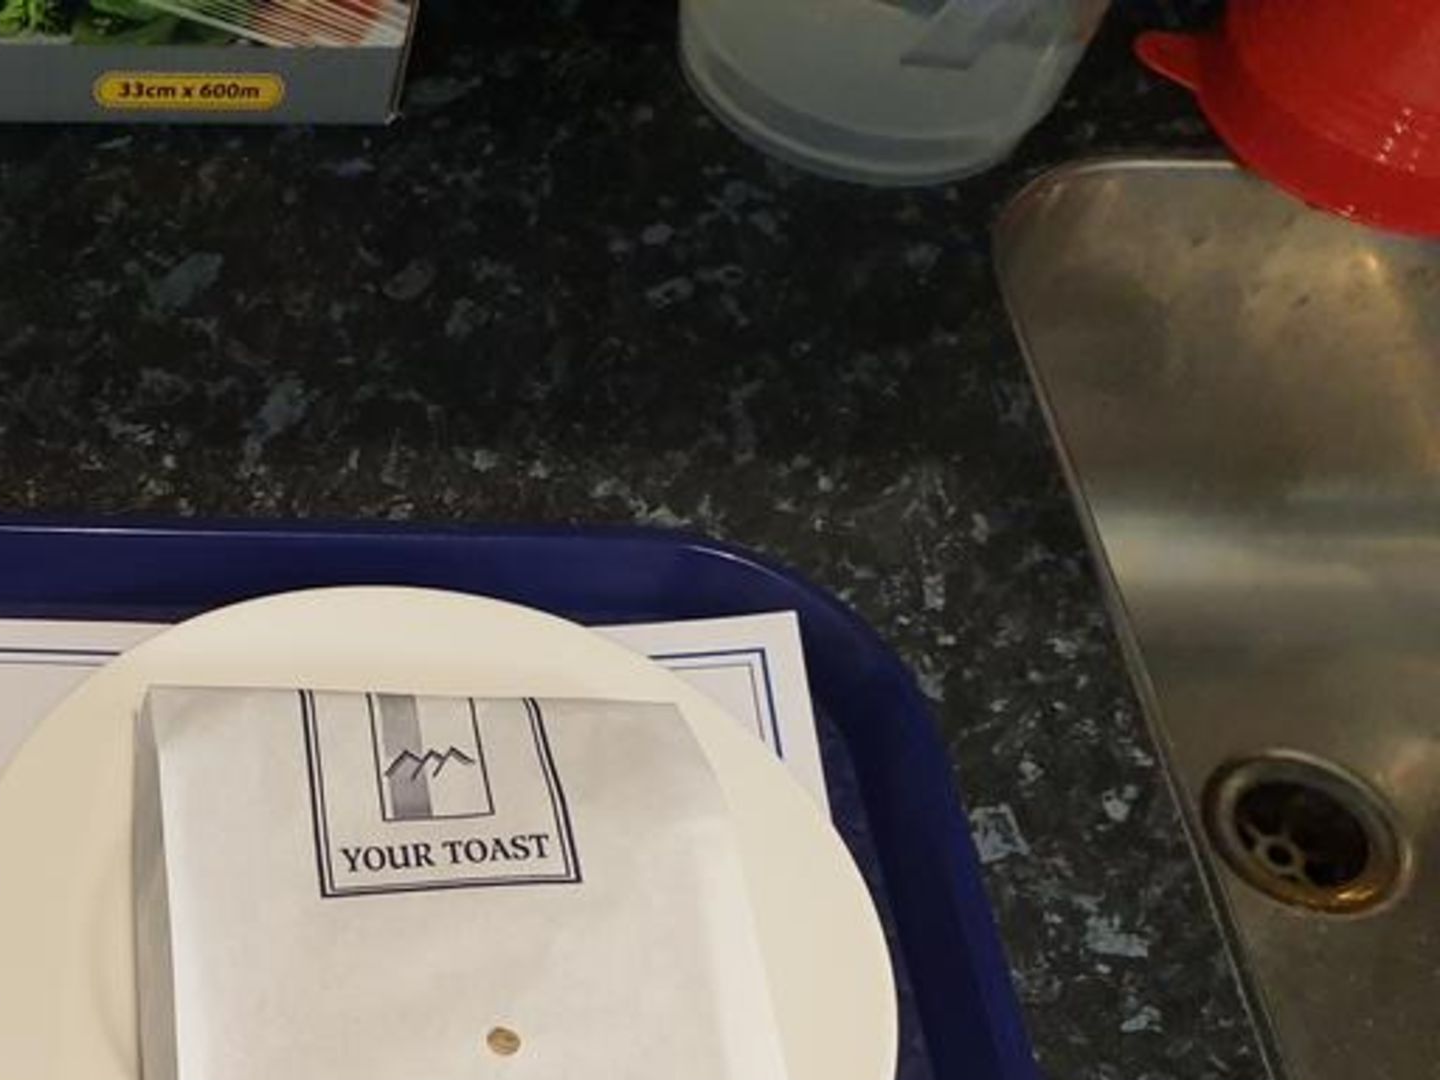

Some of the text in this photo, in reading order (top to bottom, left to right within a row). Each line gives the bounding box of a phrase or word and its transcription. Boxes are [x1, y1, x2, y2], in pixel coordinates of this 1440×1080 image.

[117, 80, 261, 99] 33cm x 600m
[340, 833, 550, 873] YOUR TOAST
